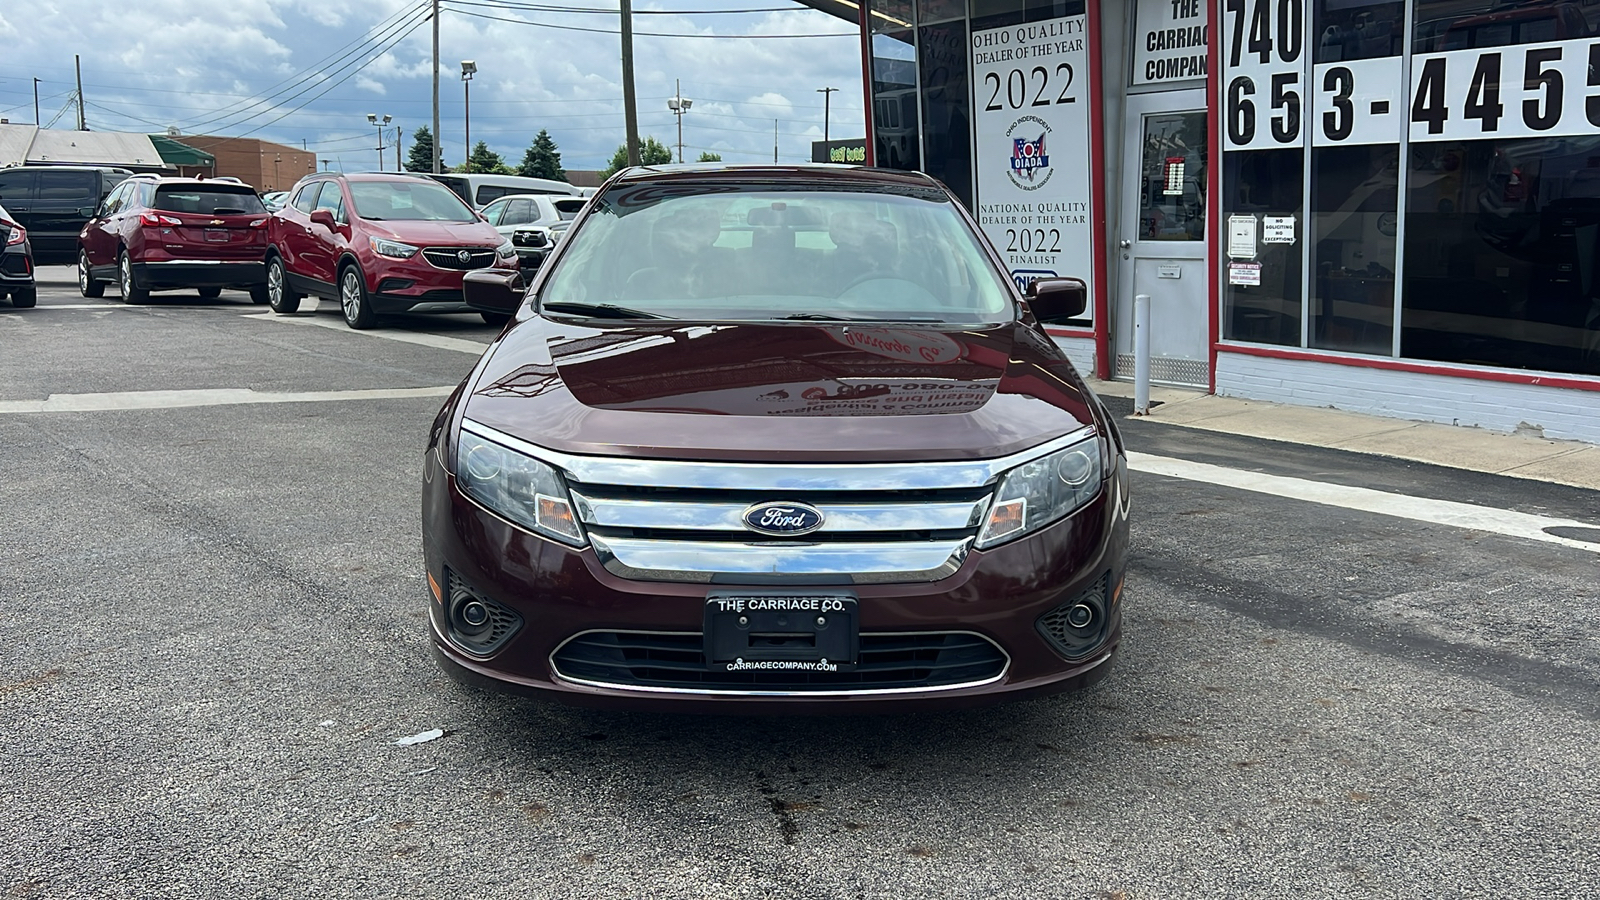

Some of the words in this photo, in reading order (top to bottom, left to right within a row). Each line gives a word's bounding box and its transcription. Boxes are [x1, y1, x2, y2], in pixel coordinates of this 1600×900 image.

[1171, 0, 1199, 20] THE
[973, 30, 1010, 48] OHIO
[1016, 19, 1085, 44] QUALITY
[1226, 0, 1303, 68] 740
[975, 48, 1013, 65] DEALER
[1015, 46, 1029, 60] OF
[1031, 43, 1053, 57] THE
[1055, 38, 1083, 54] YEAR
[984, 62, 1076, 112] 2022
[1005, 121, 1018, 138] OHIO
[1016, 115, 1053, 134] INDEPENDENT
[1014, 157, 1043, 169] OIADA
[980, 203, 1034, 214] NATIONAL
[1037, 202, 1087, 214] QUALITY
[982, 216, 1017, 225] DEALER
[1020, 216, 1033, 225] OF
[1037, 215, 1056, 224] THE
[1059, 215, 1086, 224] YEAR
[1005, 228, 1062, 253] 2022
[1009, 255, 1057, 265] FINALIST
[760, 507, 806, 528] Ford
[717, 600, 745, 612] THE
[748, 599, 819, 611] CARRIAGE
[821, 599, 846, 612] CO.
[726, 661, 838, 672] CARRIAGECOMPANY.COM
